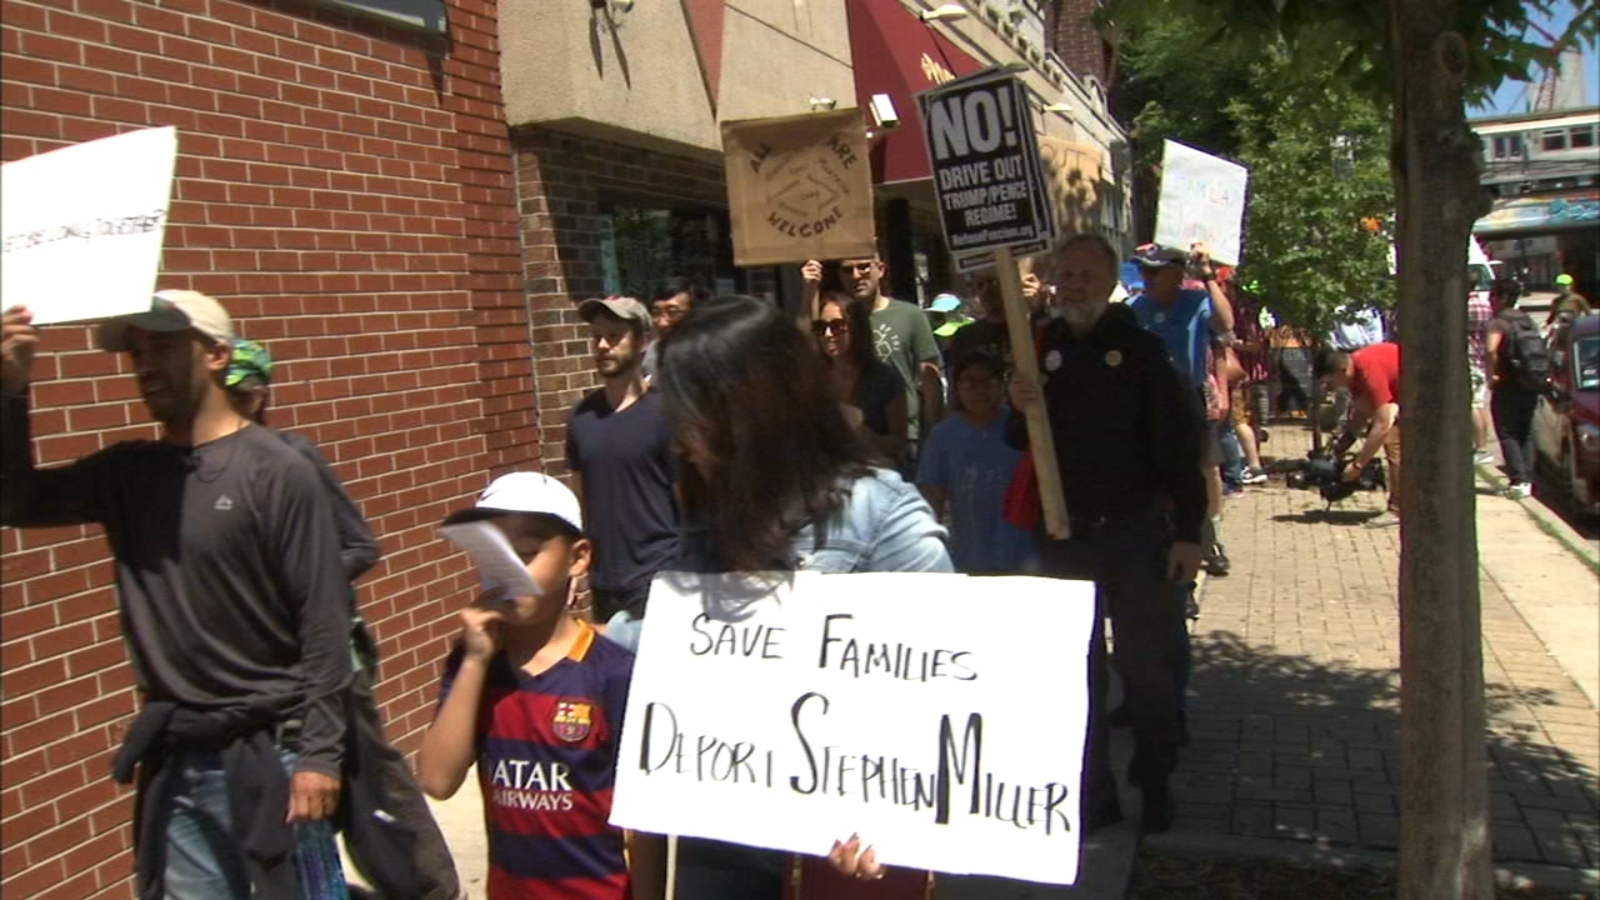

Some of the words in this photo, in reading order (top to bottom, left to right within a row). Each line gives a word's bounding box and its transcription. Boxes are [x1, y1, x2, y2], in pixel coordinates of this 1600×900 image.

[932, 87, 1016, 160] NO!
[827, 137, 858, 170] ARE
[940, 162, 991, 191] DRIVE
[994, 154, 1022, 181] OUT
[767, 206, 842, 238] WELCOME
[965, 204, 1017, 227] REGIME!
[690, 613, 787, 660] SAVE
[818, 613, 978, 683] FAMILIES
[493, 760, 573, 792] ATAR
[789, 691, 935, 812] STEPHEN
[934, 712, 1071, 836] MILLER
[493, 790, 574, 811] AIRWAYS
